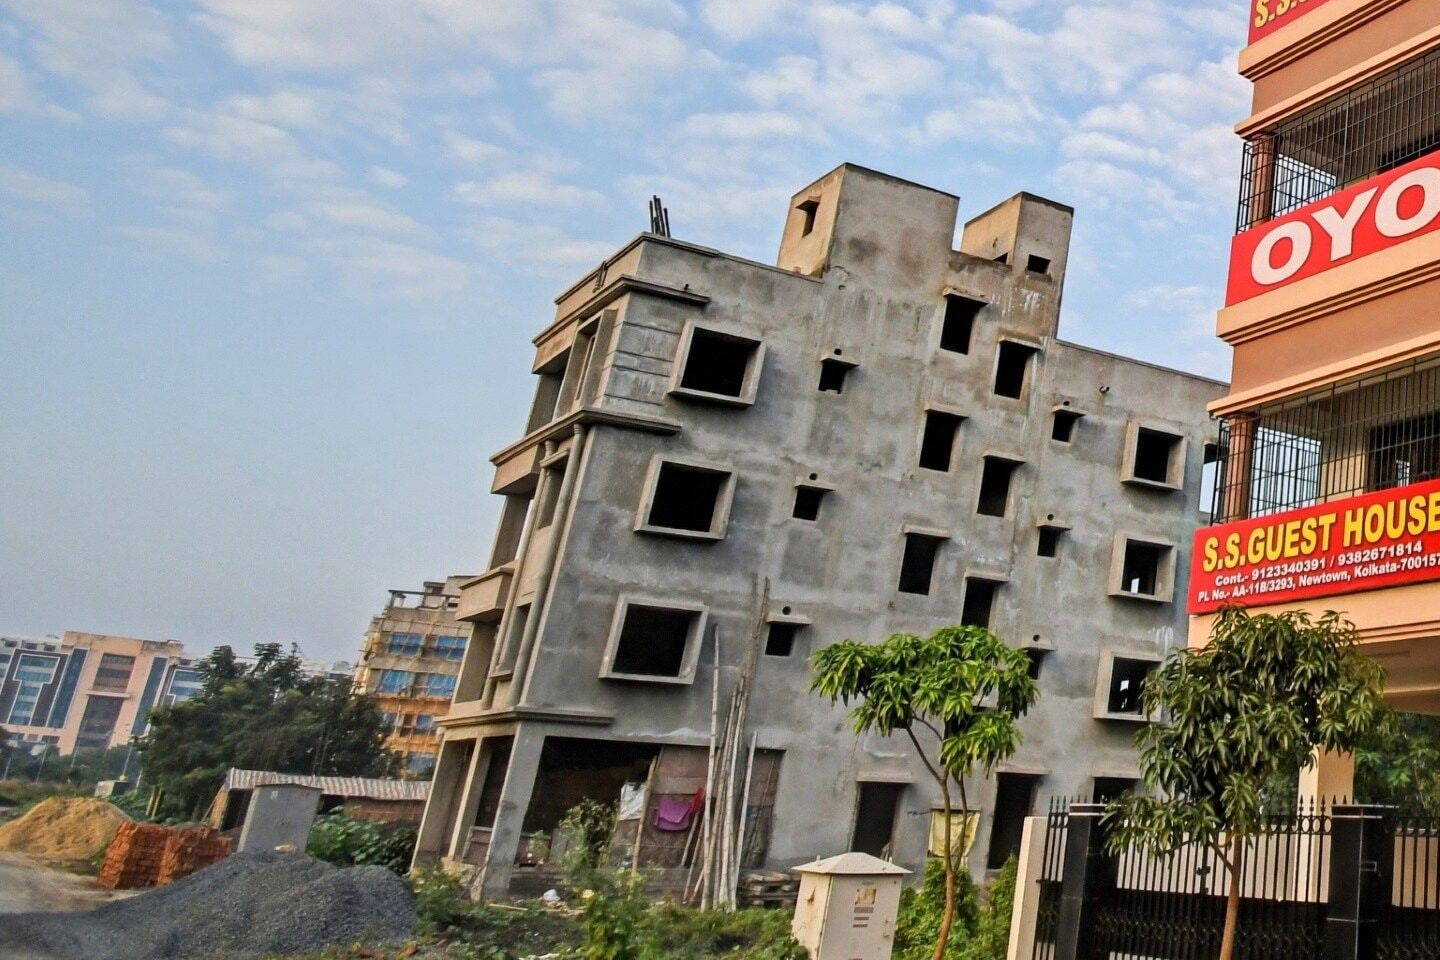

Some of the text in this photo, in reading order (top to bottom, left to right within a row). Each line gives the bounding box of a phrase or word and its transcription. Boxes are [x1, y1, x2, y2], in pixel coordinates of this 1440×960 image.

[1203, 513, 1336, 572] S.S.GUEST
[1251, 556, 1326, 580] 9123340391
[1338, 540, 1423, 565] 9382671814
[1298, 572, 1351, 587] Newtown,
